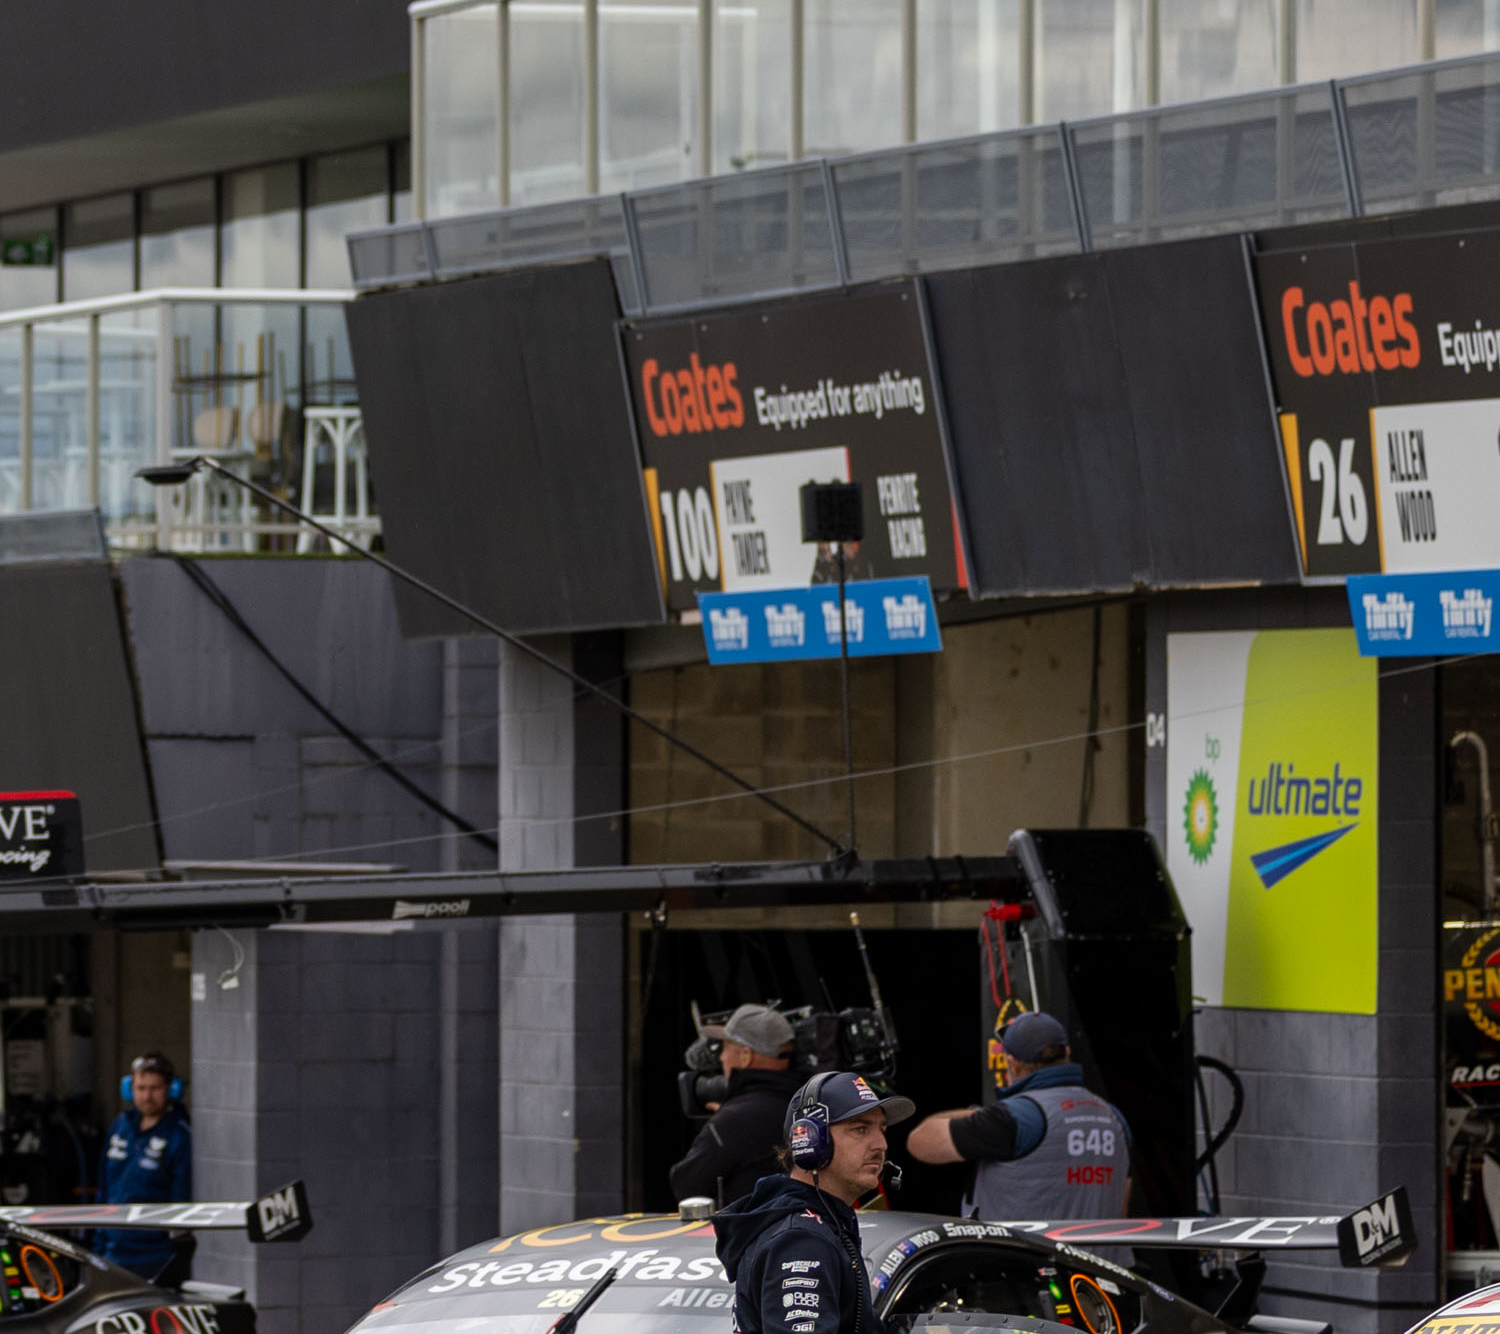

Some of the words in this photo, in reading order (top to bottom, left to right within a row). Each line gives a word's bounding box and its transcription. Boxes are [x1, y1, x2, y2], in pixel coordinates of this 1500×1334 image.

[1282, 281, 1421, 377] Coates
[642, 352, 745, 437] Coates
[754, 379, 828, 431] Equipped
[826, 379, 852, 416] for
[854, 370, 926, 420] anything
[1387, 429, 1429, 483] ALLEN
[1308, 438, 1369, 546] 26
[1395, 490, 1437, 543] WOOD
[660, 486, 719, 582] 100
[1145, 713, 1166, 747] 04
[1248, 762, 1362, 816] ultimate
[1066, 1129, 1115, 1157] 648
[1066, 1167, 1113, 1185] HOST
[880, 1252, 903, 1278] ALLEN
[909, 1229, 940, 1248] WOOD
[943, 1222, 1012, 1240] Snap-on
[536, 1289, 584, 1308] 26
[786, 1310, 820, 1319] ACDelco
[795, 1299, 819, 1308] LOCK
